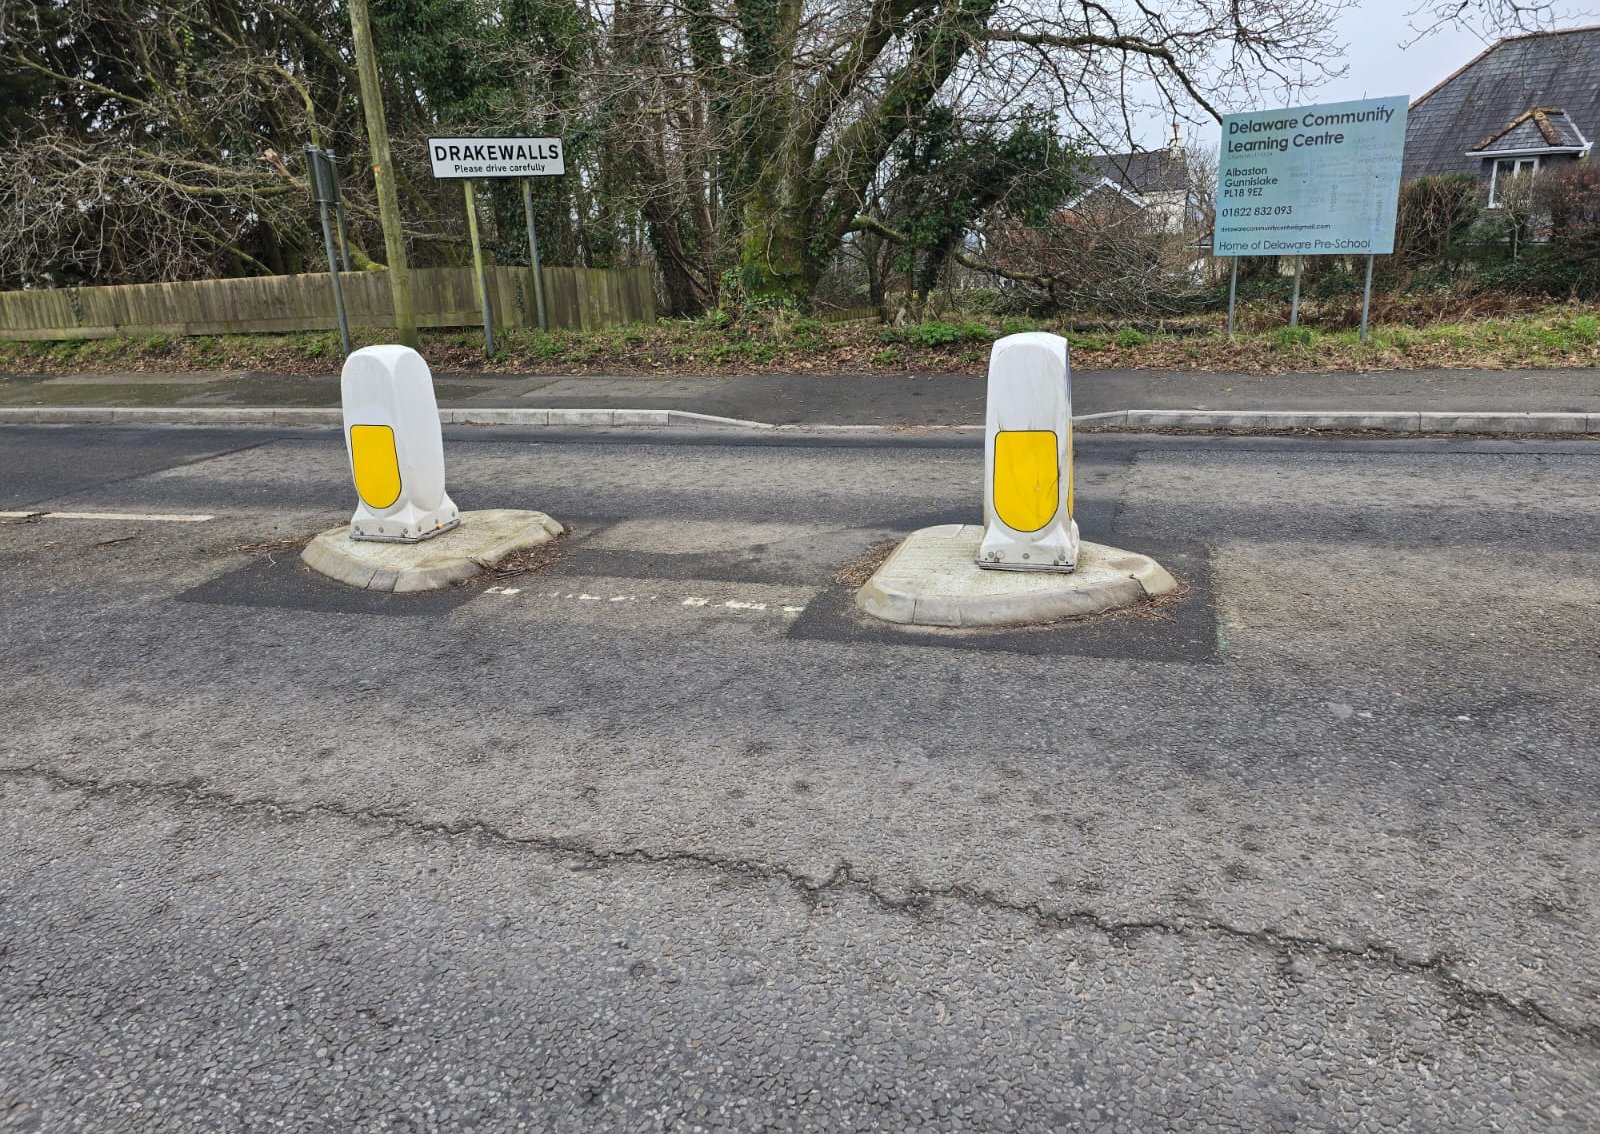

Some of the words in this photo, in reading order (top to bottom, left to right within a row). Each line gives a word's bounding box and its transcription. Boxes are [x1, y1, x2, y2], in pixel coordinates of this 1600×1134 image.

[1229, 118, 1298, 134] Delaware
[1302, 104, 1395, 128] Community
[1228, 136, 1289, 153] Learning
[1292, 131, 1345, 148] Centre
[434, 144, 559, 161] DRAKEWALLS
[454, 164, 483, 173] Please
[485, 163, 507, 172] drive
[509, 162, 546, 173] carefully
[1225, 166, 1268, 177] Albaston
[1224, 176, 1278, 188] Gunnislake
[1224, 188, 1245, 198] PL18
[1247, 187, 1263, 197] 9EZ
[1222, 207, 1252, 217] 01822
[1254, 206, 1272, 216] 832
[1274, 205, 1292, 215] 093
[1219, 241, 1249, 251] Home
[1250, 240, 1261, 249] of
[1263, 239, 1312, 250] Delaware
[1314, 237, 1371, 249] Pre-School
